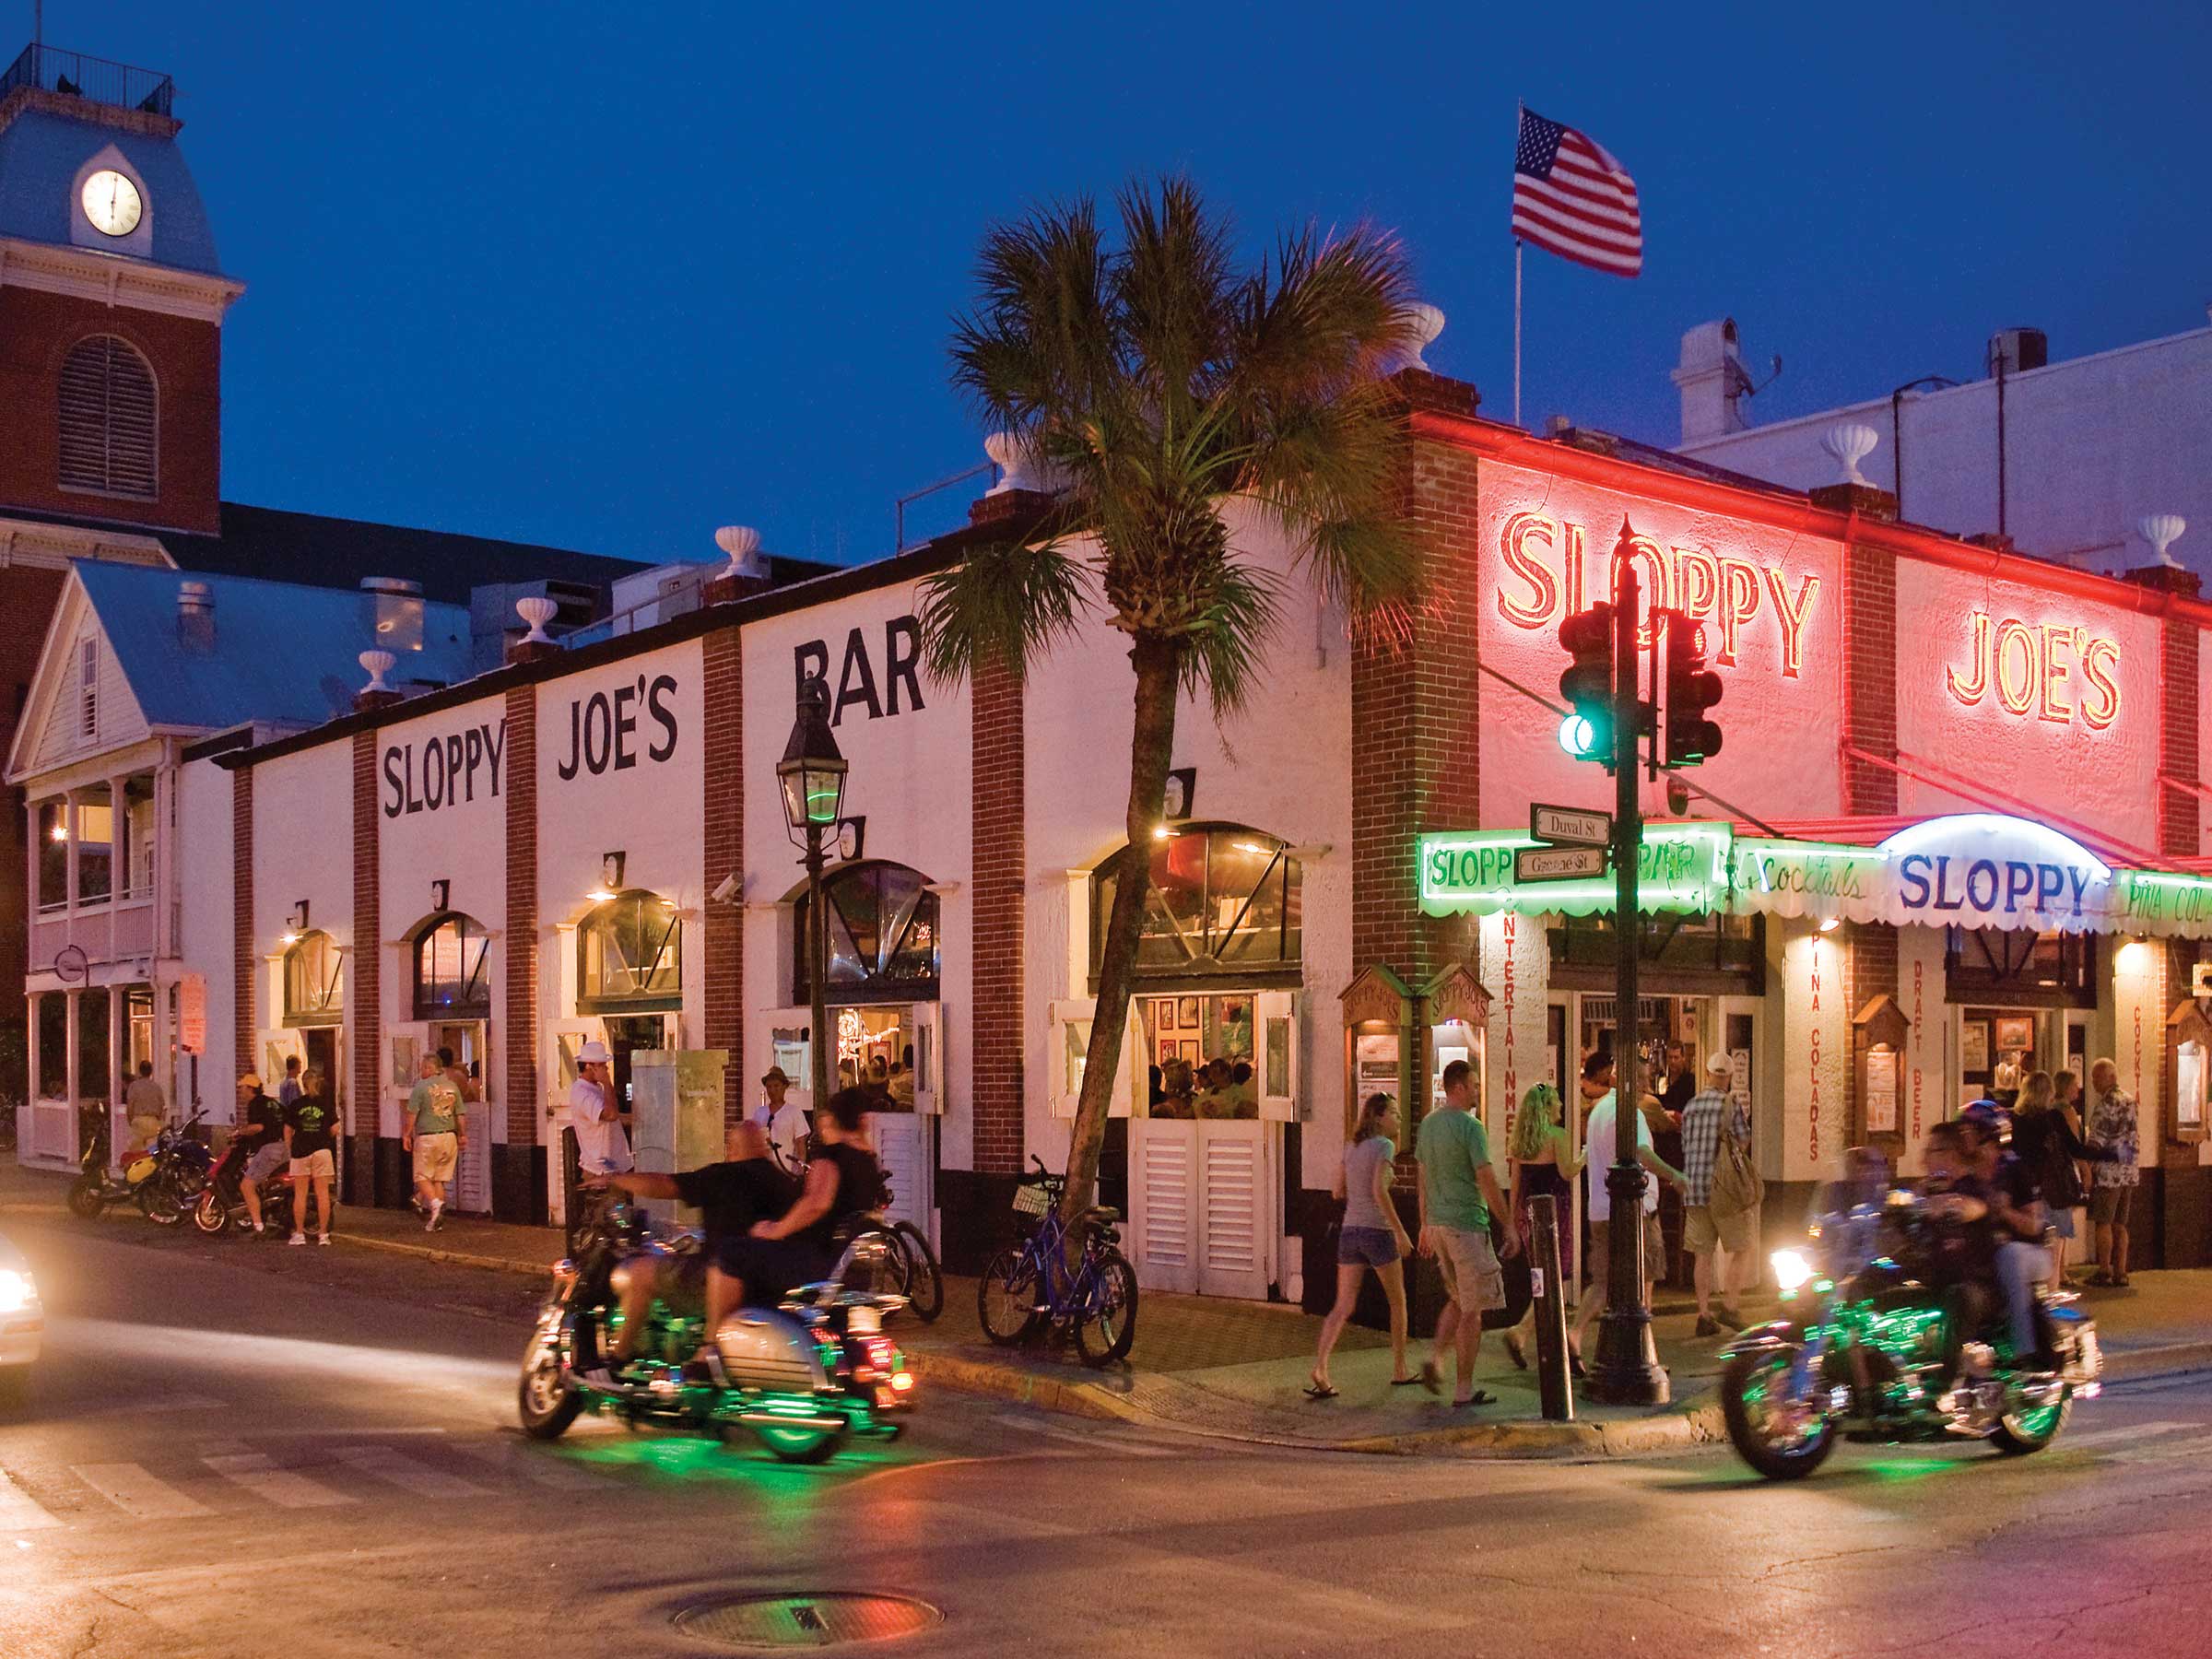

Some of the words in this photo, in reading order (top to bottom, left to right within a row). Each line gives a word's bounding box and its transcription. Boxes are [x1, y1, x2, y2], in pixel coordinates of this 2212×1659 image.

[1497, 511, 1821, 679] SLOPPY
[1947, 610, 2122, 731] JOE'S
[383, 718, 507, 818] SLOPPY
[559, 674, 677, 781] JOE'S
[794, 615, 925, 727] BAR
[1550, 816, 1583, 836] Duval
[1585, 823, 1595, 837] St
[1431, 847, 1512, 887] SLOPP
[1575, 853, 1587, 869] St
[1762, 855, 1866, 900] Cocktails
[1900, 853, 2092, 916] SLOPPY
[2175, 886, 2212, 923] COL
[1912, 959, 1922, 1053] DRAFT
[1503, 909, 1516, 1178] NTERTAINMET
[1809, 1028, 1820, 1161] COLADAS
[1912, 1068, 1922, 1139] BEER
